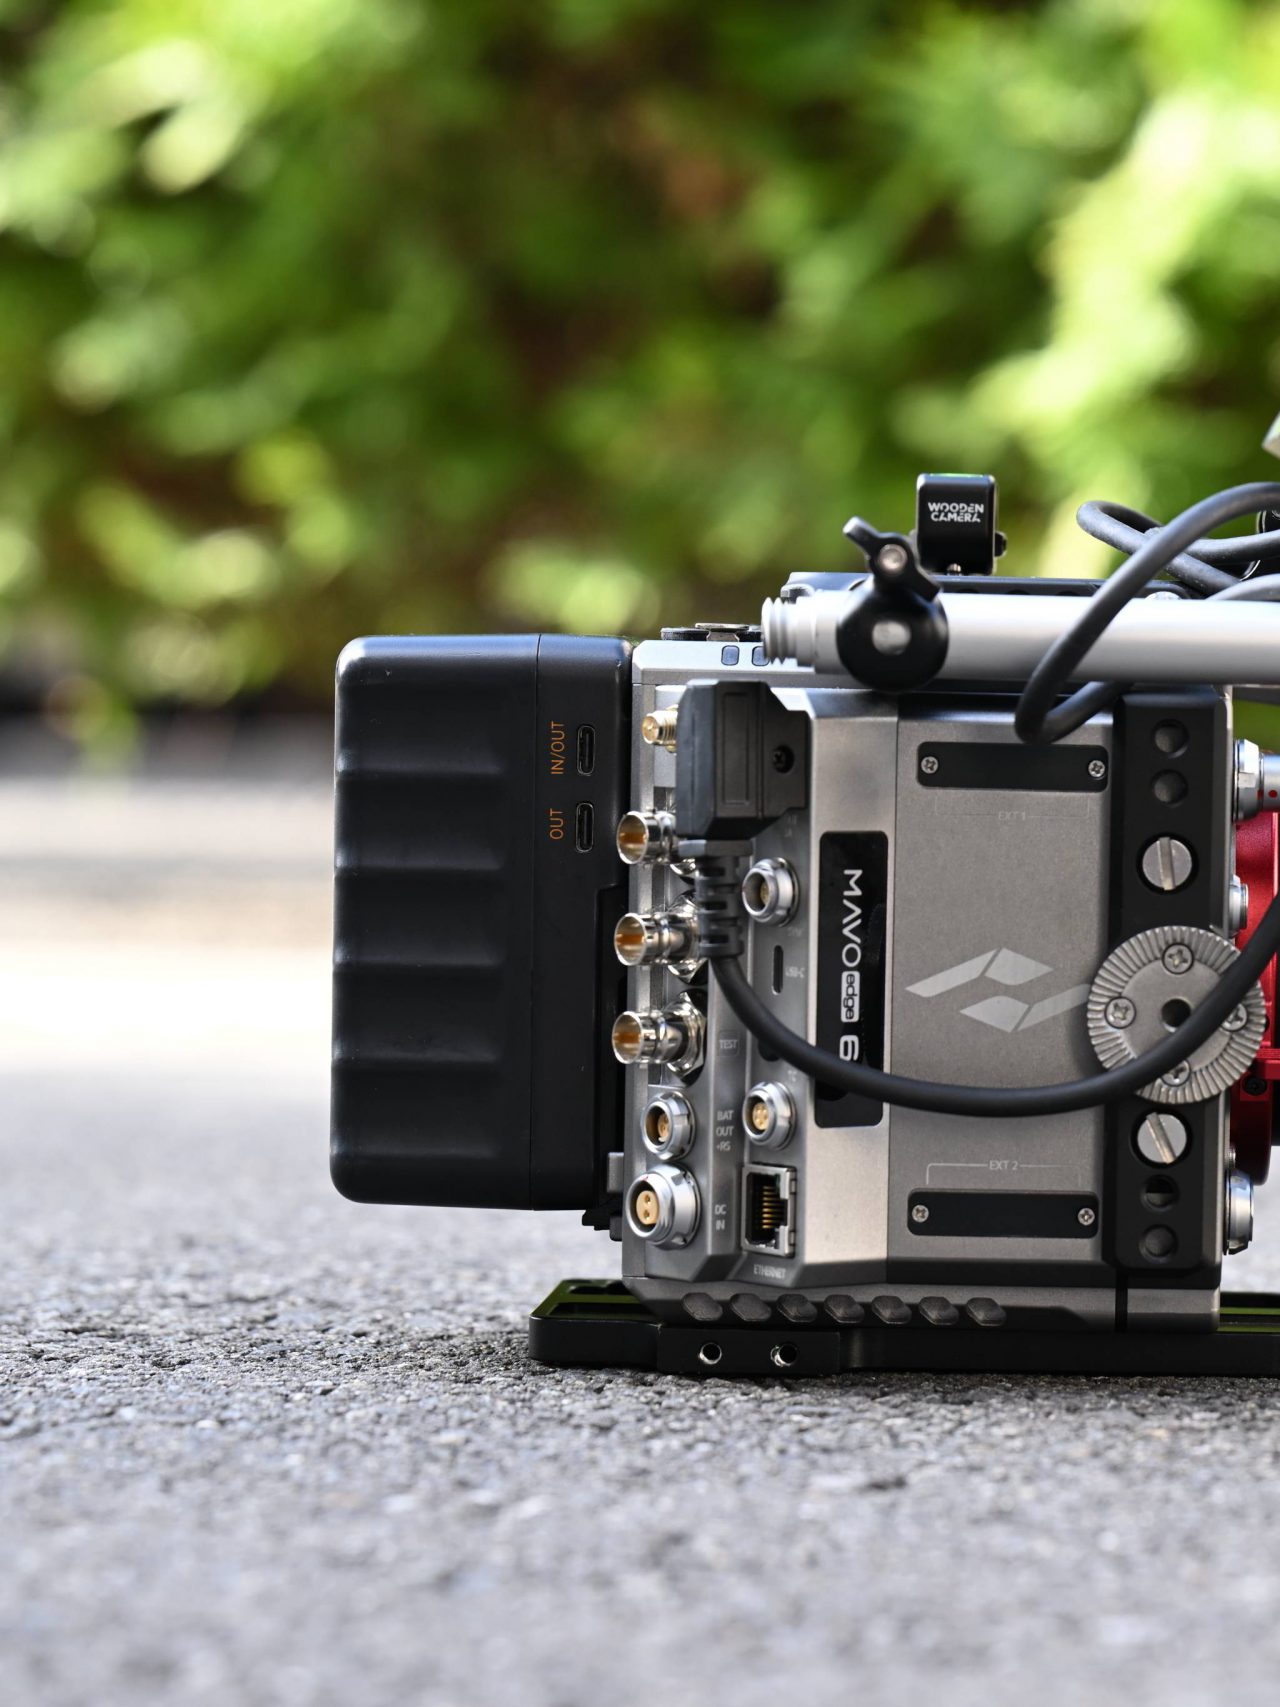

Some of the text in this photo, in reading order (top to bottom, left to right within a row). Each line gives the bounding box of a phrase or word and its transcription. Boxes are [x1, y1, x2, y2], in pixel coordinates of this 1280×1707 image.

[928, 502, 984, 513] WOODEN
[930, 512, 981, 523] CAMERA
[550, 721, 566, 775] IN/OUT
[549, 808, 564, 840] OUT
[842, 869, 863, 968] MAVO
[843, 973, 858, 1020] edge
[719, 1039, 738, 1050] TEST
[717, 1110, 734, 1121] BAT
[716, 1126, 734, 1136] OUT
[989, 1160, 1018, 1170] EXT 2
[714, 1204, 727, 1215] DC
[715, 1220, 726, 1231] IN
